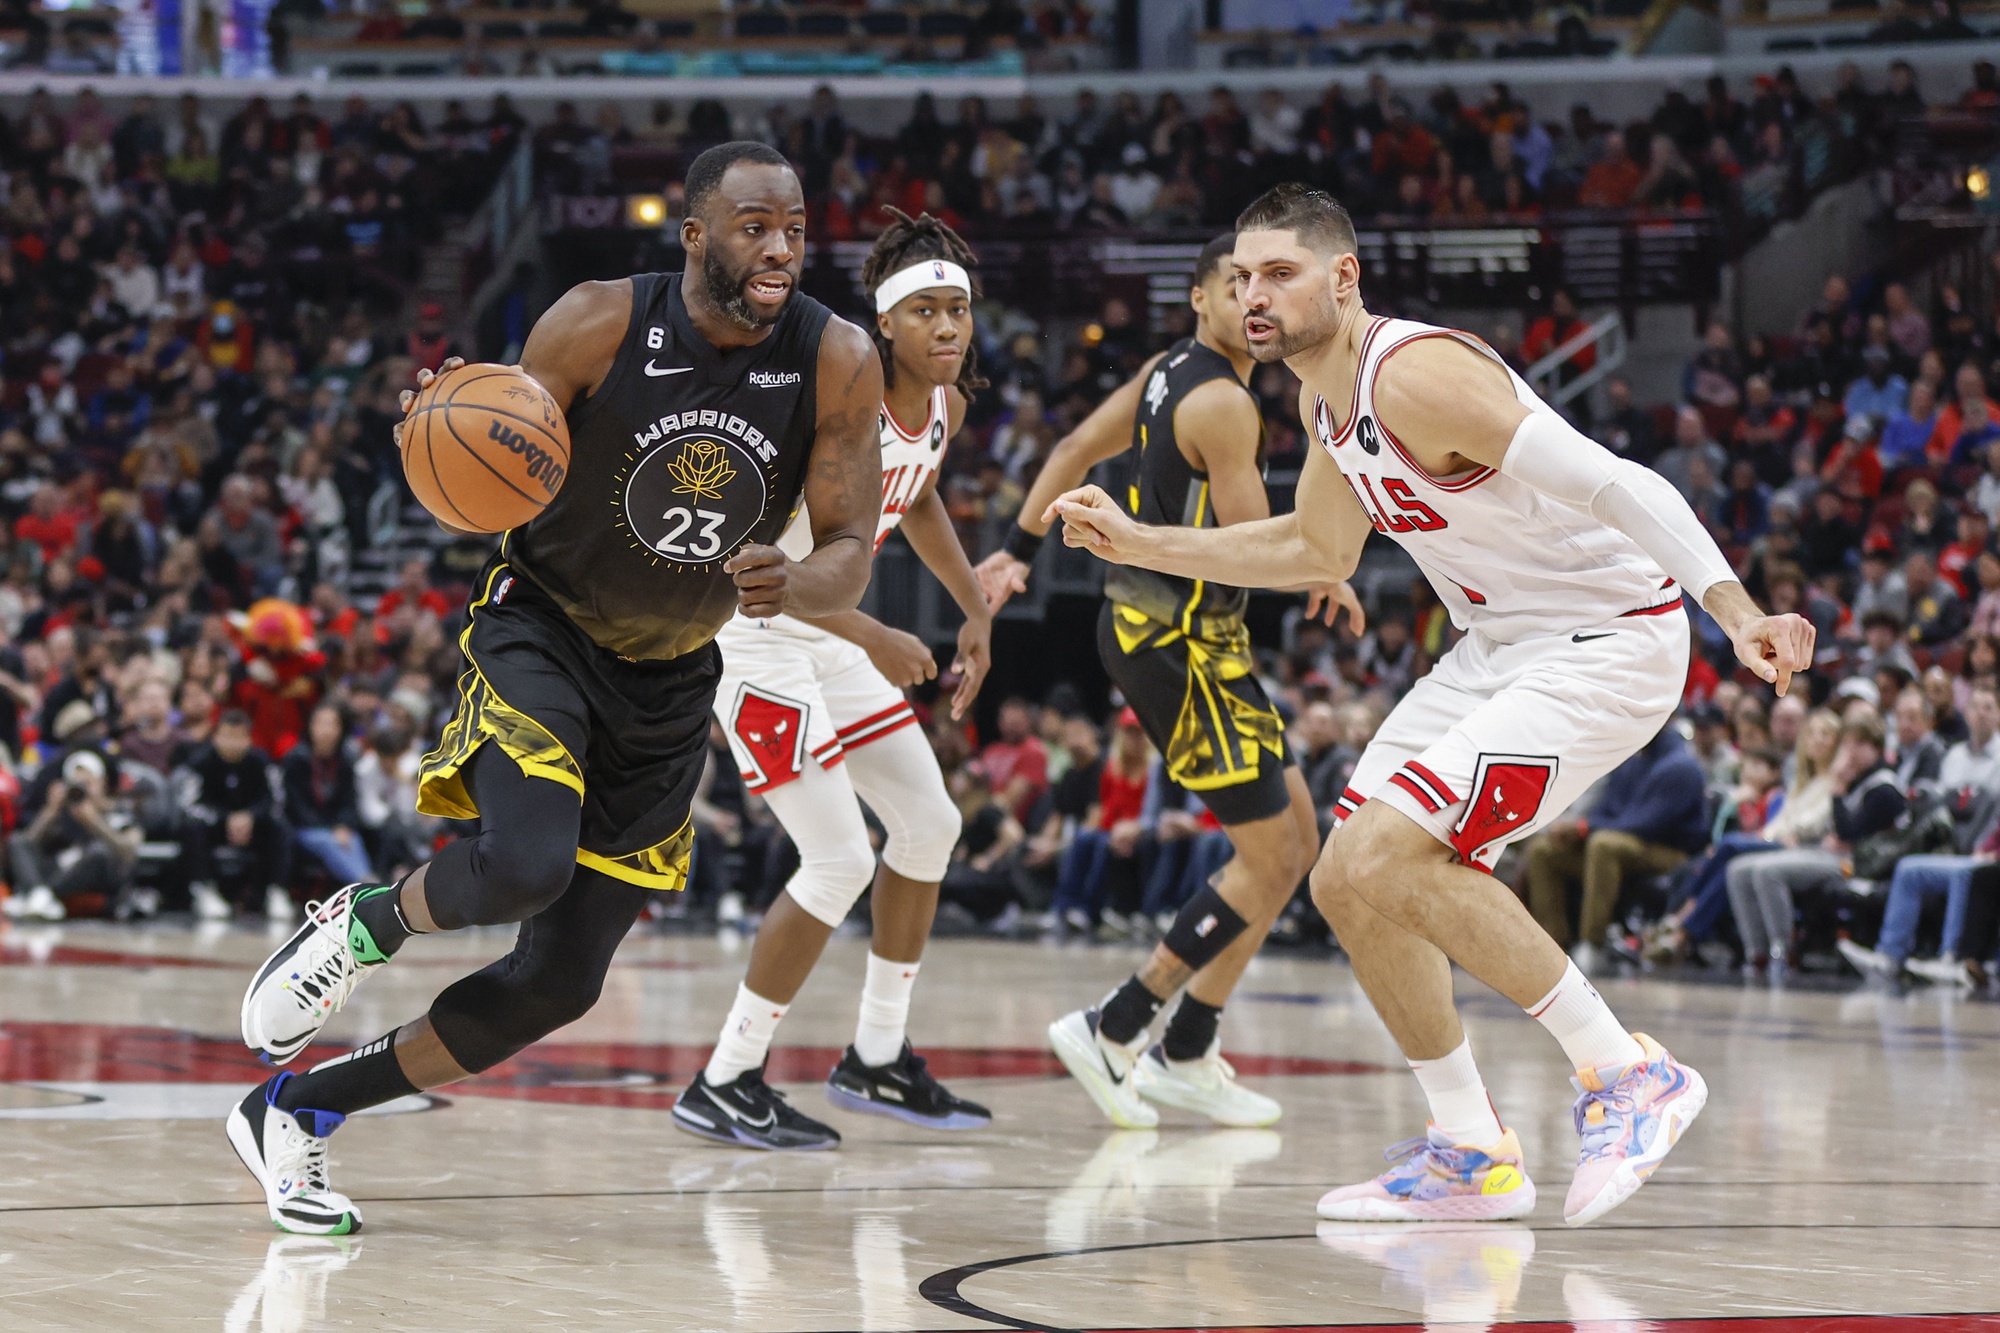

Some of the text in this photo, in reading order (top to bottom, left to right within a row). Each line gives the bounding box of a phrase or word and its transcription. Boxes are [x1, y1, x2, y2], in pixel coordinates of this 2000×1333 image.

[646, 326, 665, 350] 6
[749, 371, 801, 385] Rakuten
[488, 419, 565, 496] Wilson
[634, 409, 778, 463] WARRIORS
[655, 506, 727, 557] 23
